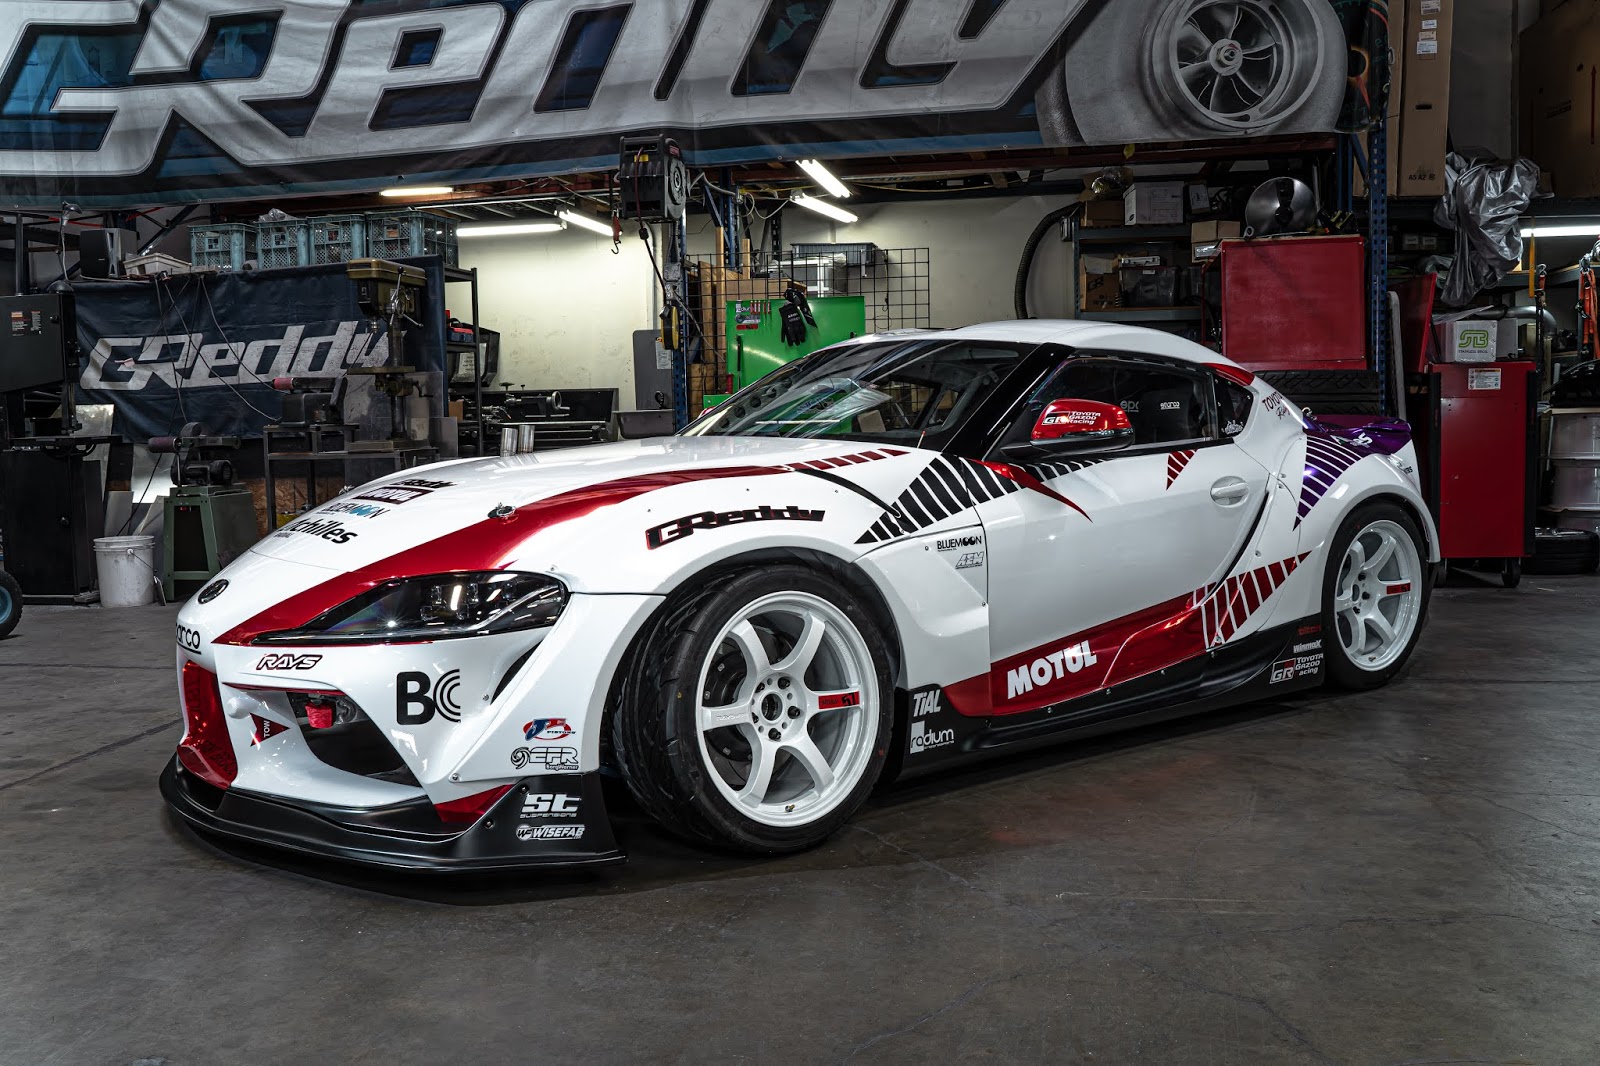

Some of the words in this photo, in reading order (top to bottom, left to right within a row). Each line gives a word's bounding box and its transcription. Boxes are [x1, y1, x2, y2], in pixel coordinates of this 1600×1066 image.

[80, 320, 405, 391] GReddy
[645, 505, 826, 550] GReddy
[936, 535, 982, 550] BLUEMOON
[176, 622, 201, 650] arco
[256, 653, 323, 671] RAYS
[1296, 653, 1324, 664] TOYOTA
[1007, 640, 1097, 699] MOTUL
[1272, 667, 1294, 681] GR
[1295, 660, 1320, 671] GAZOO
[1298, 667, 1319, 677] acing
[396, 668, 462, 726] BC
[263, 720, 271, 738] TOW
[528, 747, 579, 764] EFR
[533, 826, 586, 838] WISEFAB
